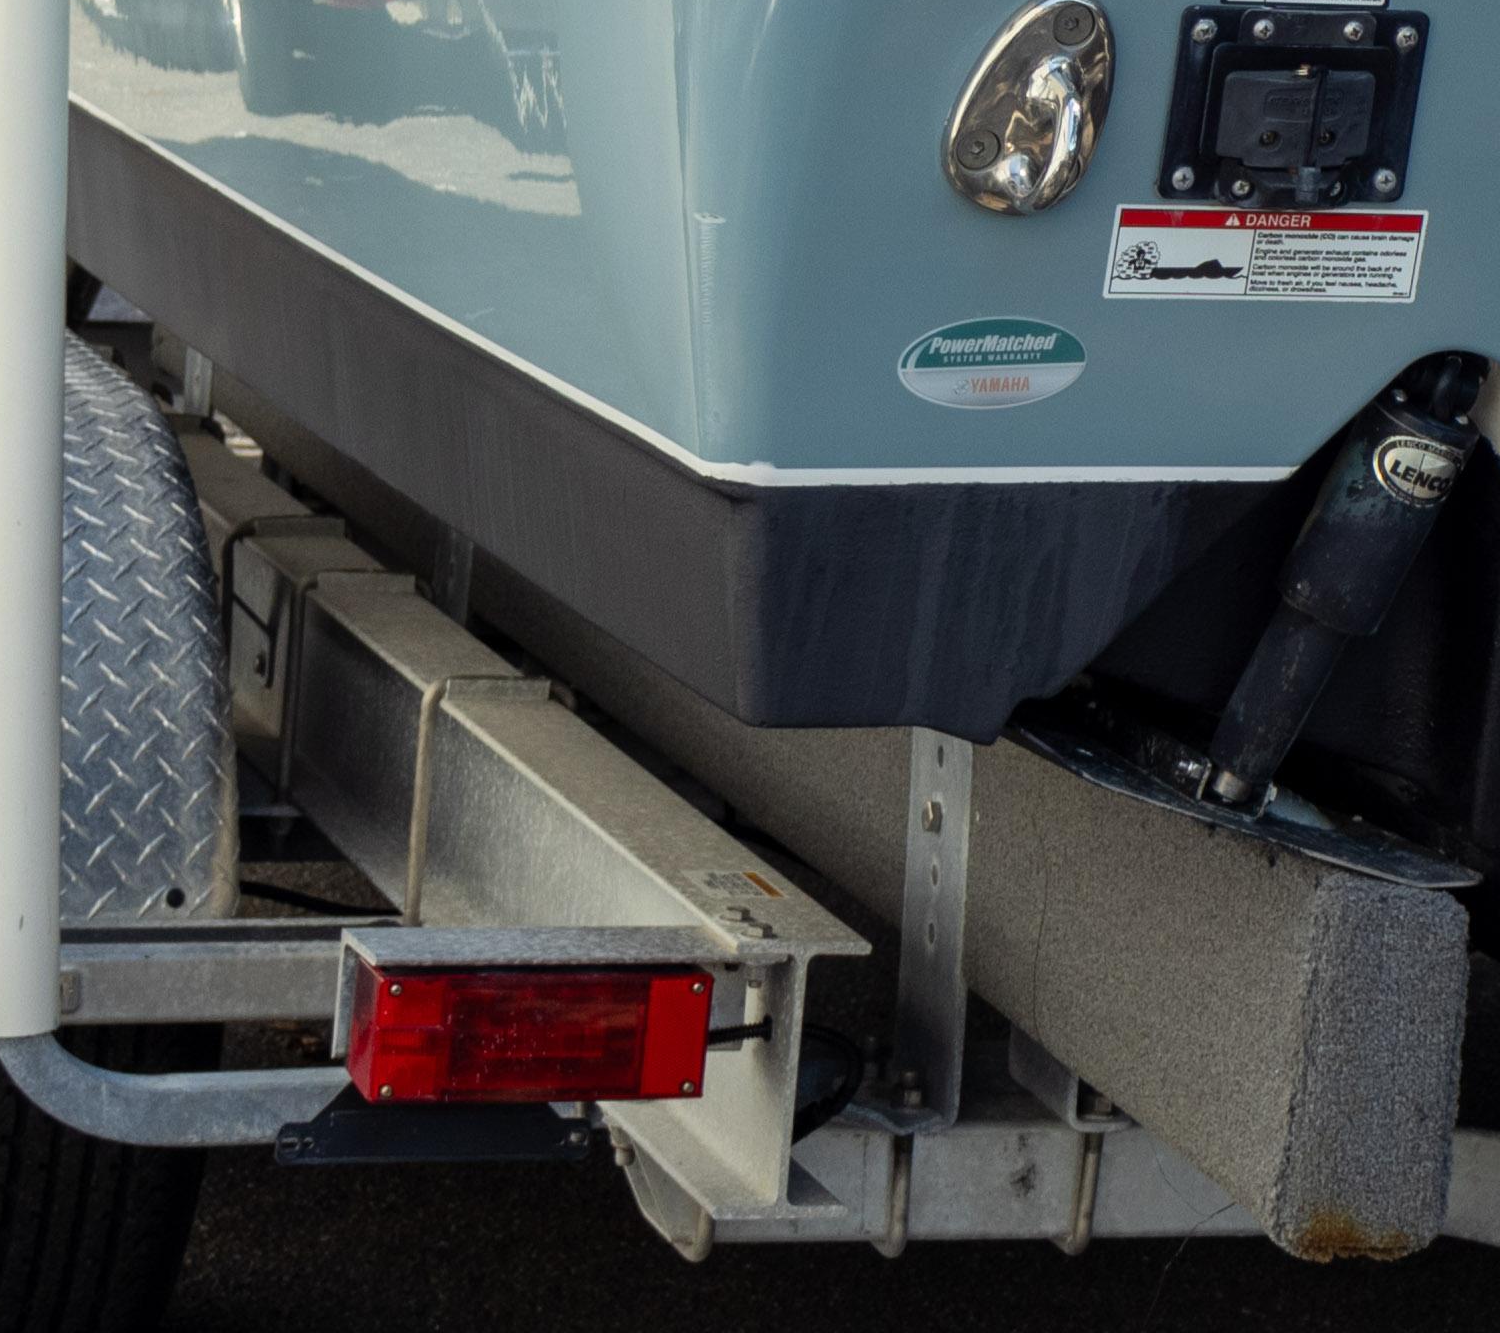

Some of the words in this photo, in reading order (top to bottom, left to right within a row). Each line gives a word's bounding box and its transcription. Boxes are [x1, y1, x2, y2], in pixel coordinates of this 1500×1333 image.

[1245, 214, 1311, 228] DANGER
[1320, 233, 1335, 241] (CO)
[1255, 247, 1277, 257] Engine
[929, 333, 1058, 355] PowerMatched
[943, 354, 983, 363] SYSTEM
[970, 376, 1030, 394] YAMAHA
